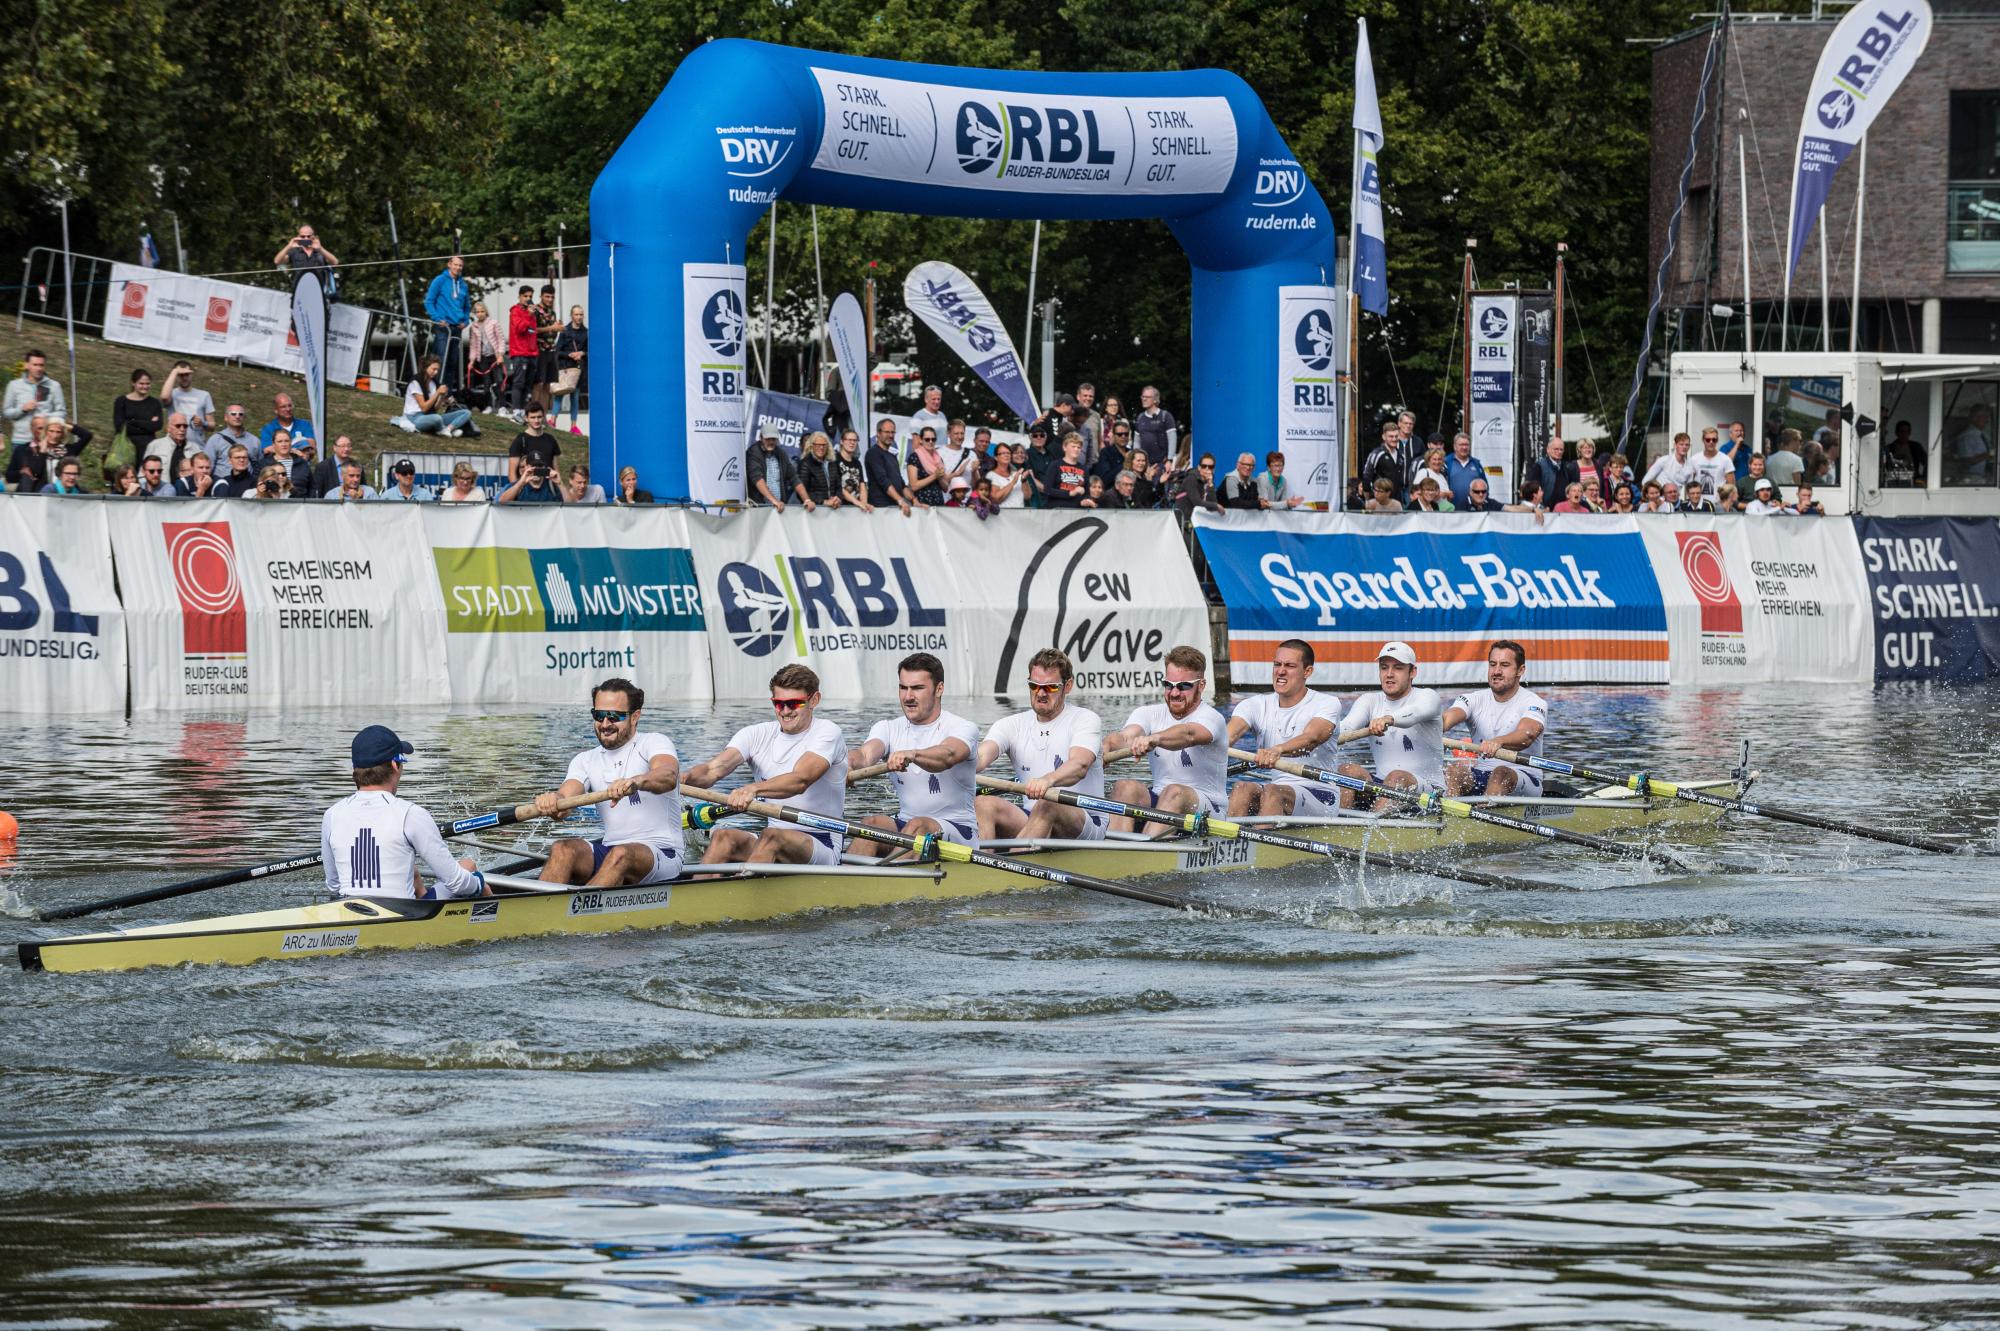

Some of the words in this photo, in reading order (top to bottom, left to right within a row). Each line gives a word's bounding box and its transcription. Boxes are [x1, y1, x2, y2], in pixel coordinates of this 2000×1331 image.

[1838, 10, 1913, 90] RBL
[837, 84, 887, 108] STARK.
[843, 110, 906, 138] SCHNELL.
[1147, 111, 1194, 129] STARK.
[716, 126, 754, 134] Deutscher
[754, 126, 797, 136] Ruderverband
[1006, 105, 1115, 165] RBL
[720, 138, 779, 165] DRV
[838, 139, 869, 162] GUT.
[1152, 136, 1211, 156] SCHNELL.
[1804, 141, 1832, 152] STARK.
[1802, 162, 1821, 172] GUT.
[1803, 152, 1838, 164] SCHNELL.
[1006, 164, 1111, 182] RUDER-BUNDESLIGA
[1146, 164, 1177, 182] GUT.
[1255, 170, 1299, 194] DRV
[1246, 212, 1317, 230] rudern.de
[1479, 346, 1507, 358] RBL
[1473, 376, 1496, 384] STARK.
[1473, 384, 1503, 392] SCHNELL.
[1294, 385, 1334, 406] RBL
[695, 420, 719, 428] STARK.
[1286, 428, 1309, 436] STARK.
[1863, 537, 1959, 573] STARK.
[267, 560, 372, 580] GEMEINSAM
[1751, 560, 1819, 579] GEMEINSAM
[272, 585, 324, 604] MEHR
[452, 585, 534, 617] STADT
[579, 576, 703, 617] MÜNSTER
[788, 556, 947, 630] RBL
[1260, 552, 1616, 626] Sparda-Bank
[1756, 580, 1790, 596] MEHR
[1761, 599, 1825, 617] ERREICHEN.
[1876, 583, 1999, 620] SCHNELL.
[279, 609, 374, 629] ERREICHEN.
[810, 633, 948, 652] RUDER-BUNDESLIGA
[1701, 641, 1747, 654] RUDER-CLUB
[1883, 632, 1941, 668] GUT.
[546, 644, 636, 676] Sportamt
[1702, 655, 1747, 667] DEUTSCHLAND
[184, 666, 248, 680] RUDER-CLUB
[1072, 671, 1164, 690] ORTSWEAR
[185, 683, 249, 696] DEUTSCHLAND
[1743, 805, 1759, 813] RBL
[1471, 811, 1492, 821] STARK.
[1492, 816, 1521, 828] SCHNELL.
[1521, 823, 1536, 832] GUT.
[1539, 826, 1555, 836] RBL
[1240, 830, 1262, 841] STARK.
[1262, 835, 1293, 847] SCHNELL.
[1294, 841, 1310, 849] GUT.
[1313, 843, 1330, 852] RBL
[269, 862, 290, 872] STARK.
[289, 857, 317, 868] SCHNELL.
[973, 855, 996, 867] STARK.
[997, 861, 1029, 874] SCHNELL.
[1029, 869, 1045, 878] GUT.
[1050, 873, 1068, 882] RBL
[583, 893, 603, 909] RBL
[605, 891, 668, 908] RUDER-BUNDESLIGA
[283, 935, 306, 950] ARC
[307, 937, 319, 948] zu
[321, 933, 358, 947] Münster
